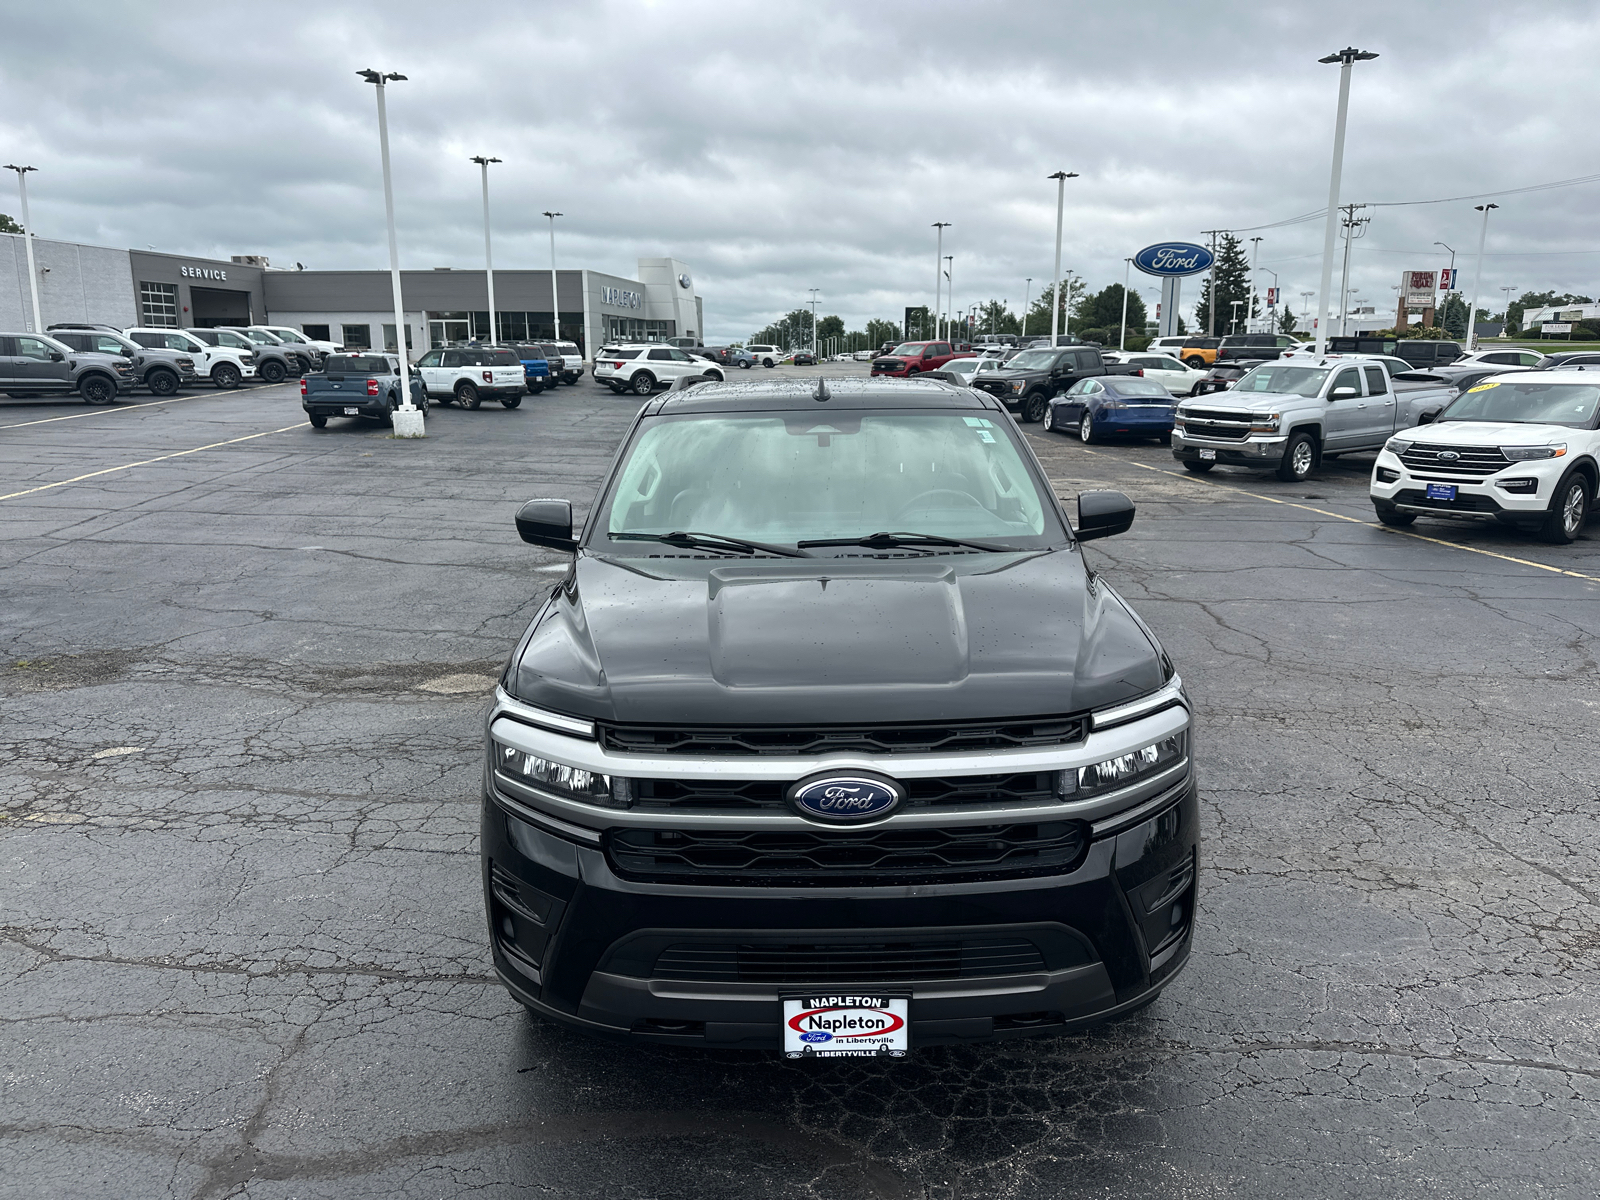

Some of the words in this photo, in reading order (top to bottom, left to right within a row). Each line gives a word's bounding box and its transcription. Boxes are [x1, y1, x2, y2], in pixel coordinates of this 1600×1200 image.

[1152, 248, 1199, 269] Ford
[181, 266, 227, 281] SERVICE
[601, 286, 642, 309] NAPLETON
[819, 786, 874, 810] Ford
[810, 996, 882, 1008] NAPLETON
[808, 1015, 885, 1032] Napleton
[805, 1032, 827, 1042] Ford
[816, 1050, 877, 1058] LIBERTYVILLE
